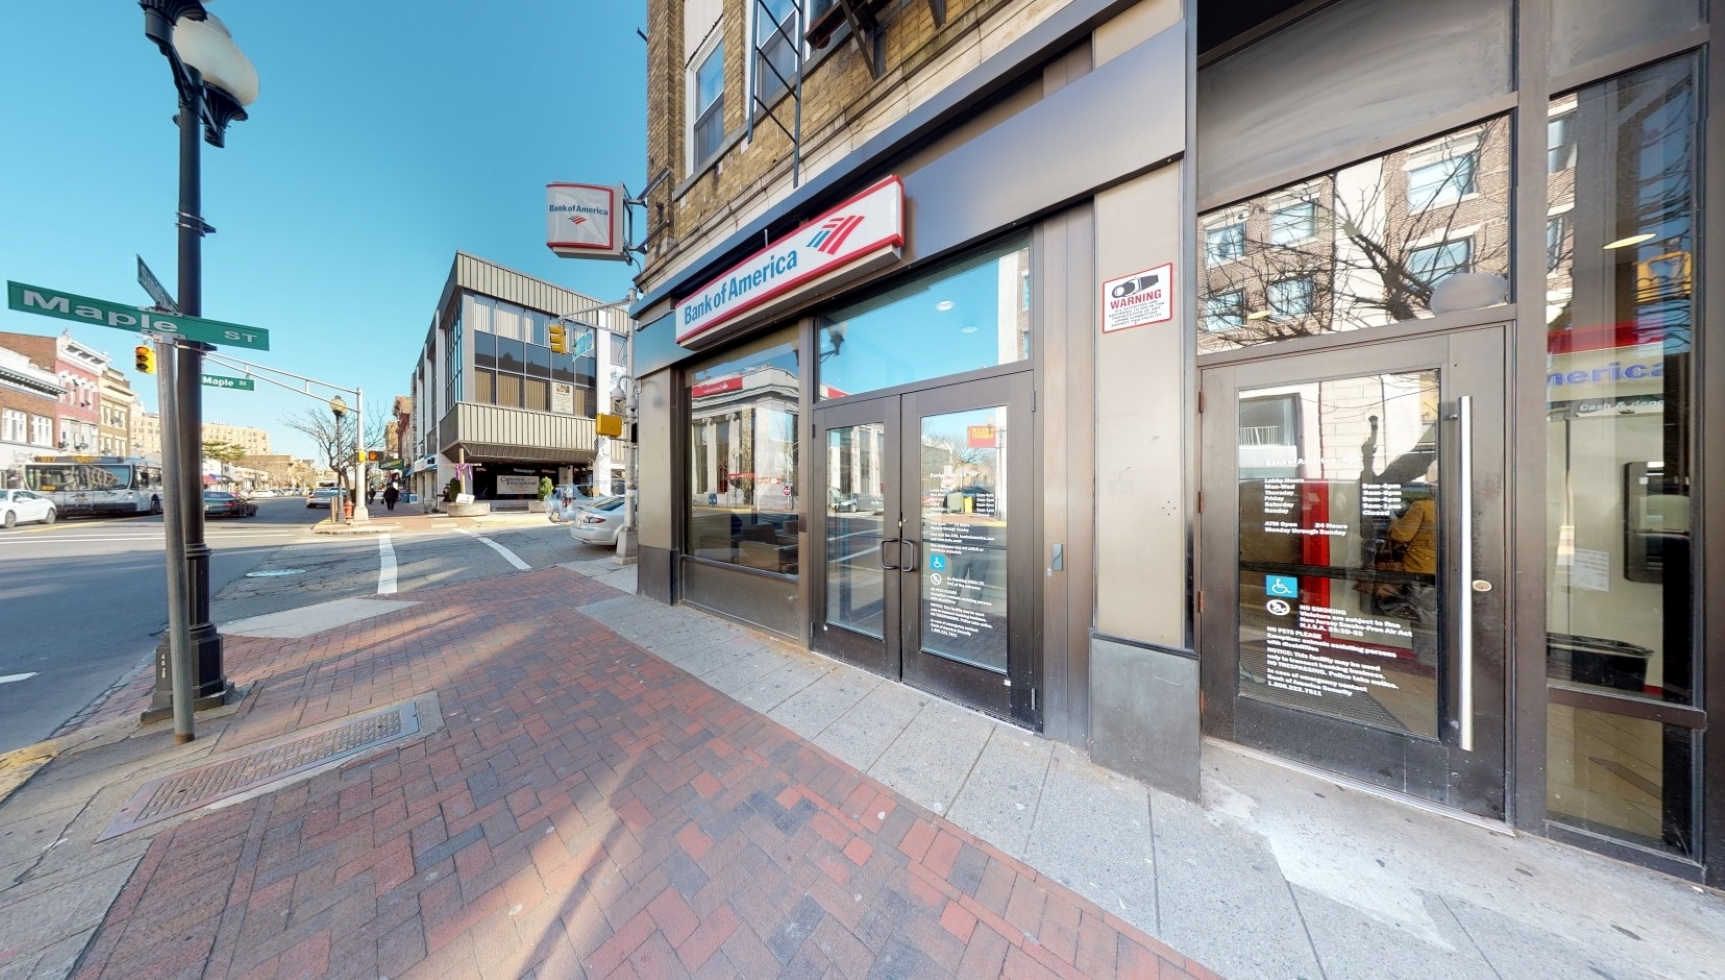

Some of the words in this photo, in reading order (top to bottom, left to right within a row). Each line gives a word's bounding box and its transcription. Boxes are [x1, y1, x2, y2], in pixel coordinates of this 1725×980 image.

[576, 205, 608, 215] America
[684, 294, 712, 325] Bank
[713, 282, 727, 308] of
[728, 250, 797, 301] America
[1110, 289, 1162, 310] WARNING
[23, 290, 178, 332] Maple
[224, 330, 257, 343] ST
[202, 377, 234, 387] Maple
[1580, 402, 1611, 412] Cash
[1312, 605, 1347, 615] SMOKING
[1300, 611, 1331, 620] Violators
[1345, 616, 1374, 625] subject
[1316, 618, 1338, 627] Jersey
[1339, 622, 1384, 633] Smoke-Free
[1296, 630, 1322, 639] PLEASE
[1282, 641, 1319, 652] disabilities
[1267, 647, 1293, 656] NOTICE:
[1309, 654, 1333, 664] facility
[1267, 674, 1284, 682] Bank
[1293, 679, 1321, 690] America
[1322, 685, 1352, 696] Security
[1300, 675, 1338, 688] emergency
[1338, 682, 1368, 692] contact
